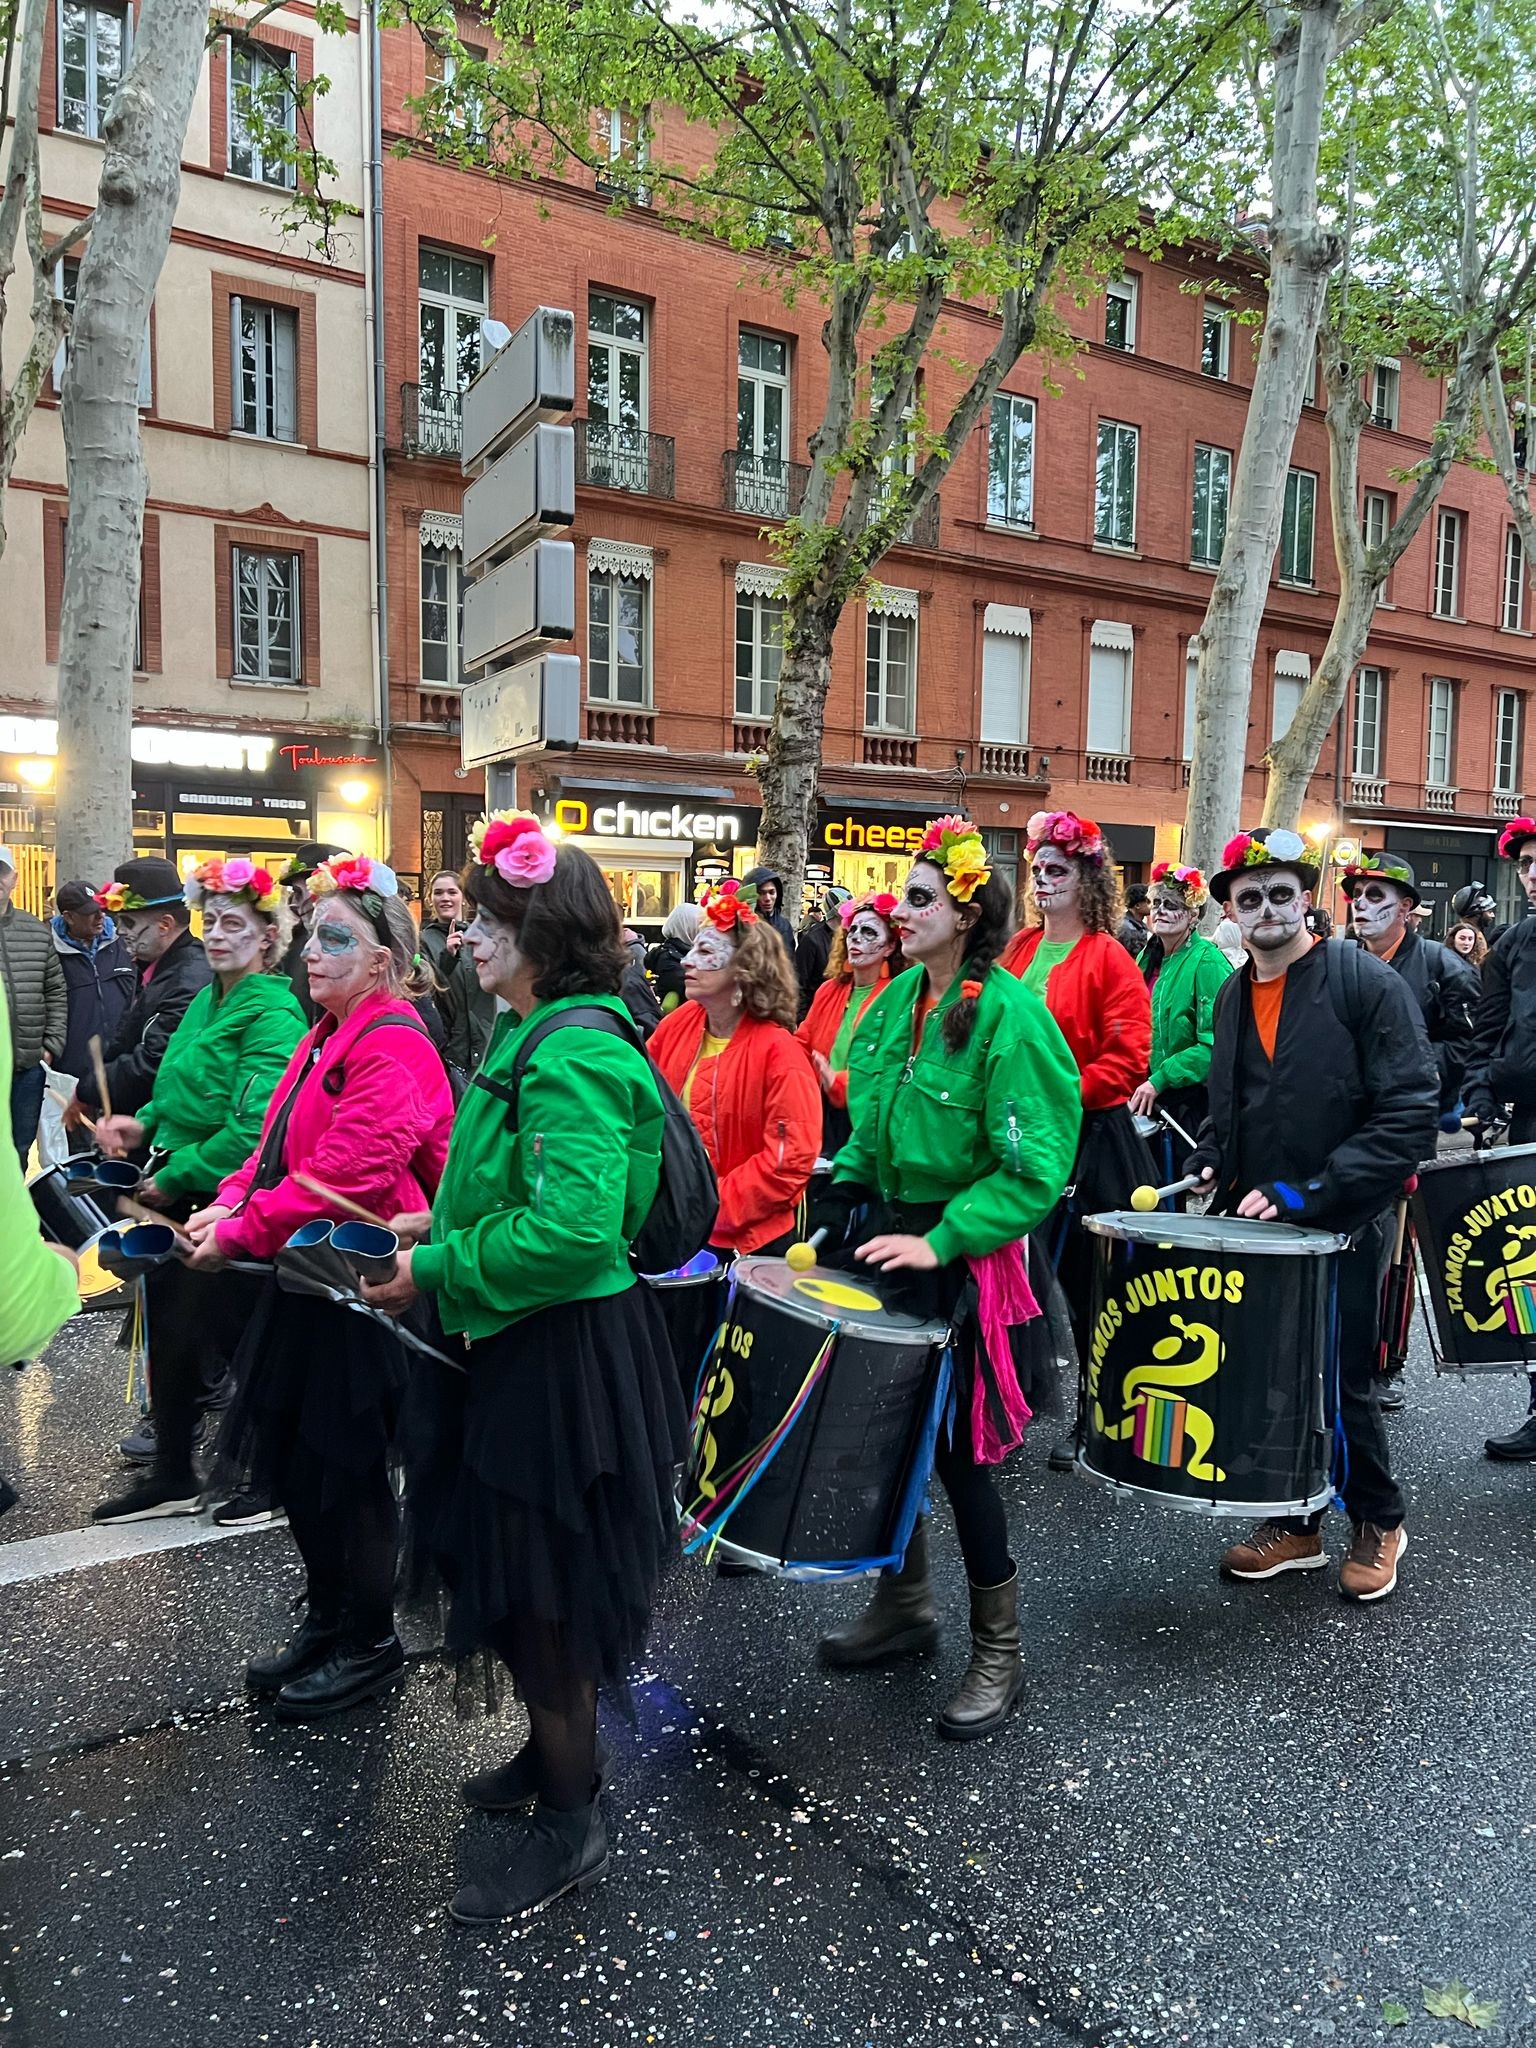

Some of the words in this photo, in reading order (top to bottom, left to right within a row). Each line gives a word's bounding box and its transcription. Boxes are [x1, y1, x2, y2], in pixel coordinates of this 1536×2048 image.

[279, 744, 377, 770] Toulousain
[179, 793, 253, 807] SANDWICH
[262, 798, 307, 810] TACOS
[592, 800, 741, 842] chicken
[824, 816, 926, 849] chees
[1444, 1232, 1472, 1315] TAMOS
[1463, 1184, 1536, 1237] JUNTO
[1087, 1298, 1123, 1399] TAMOS
[1125, 1265, 1245, 1314] JUNTOS
